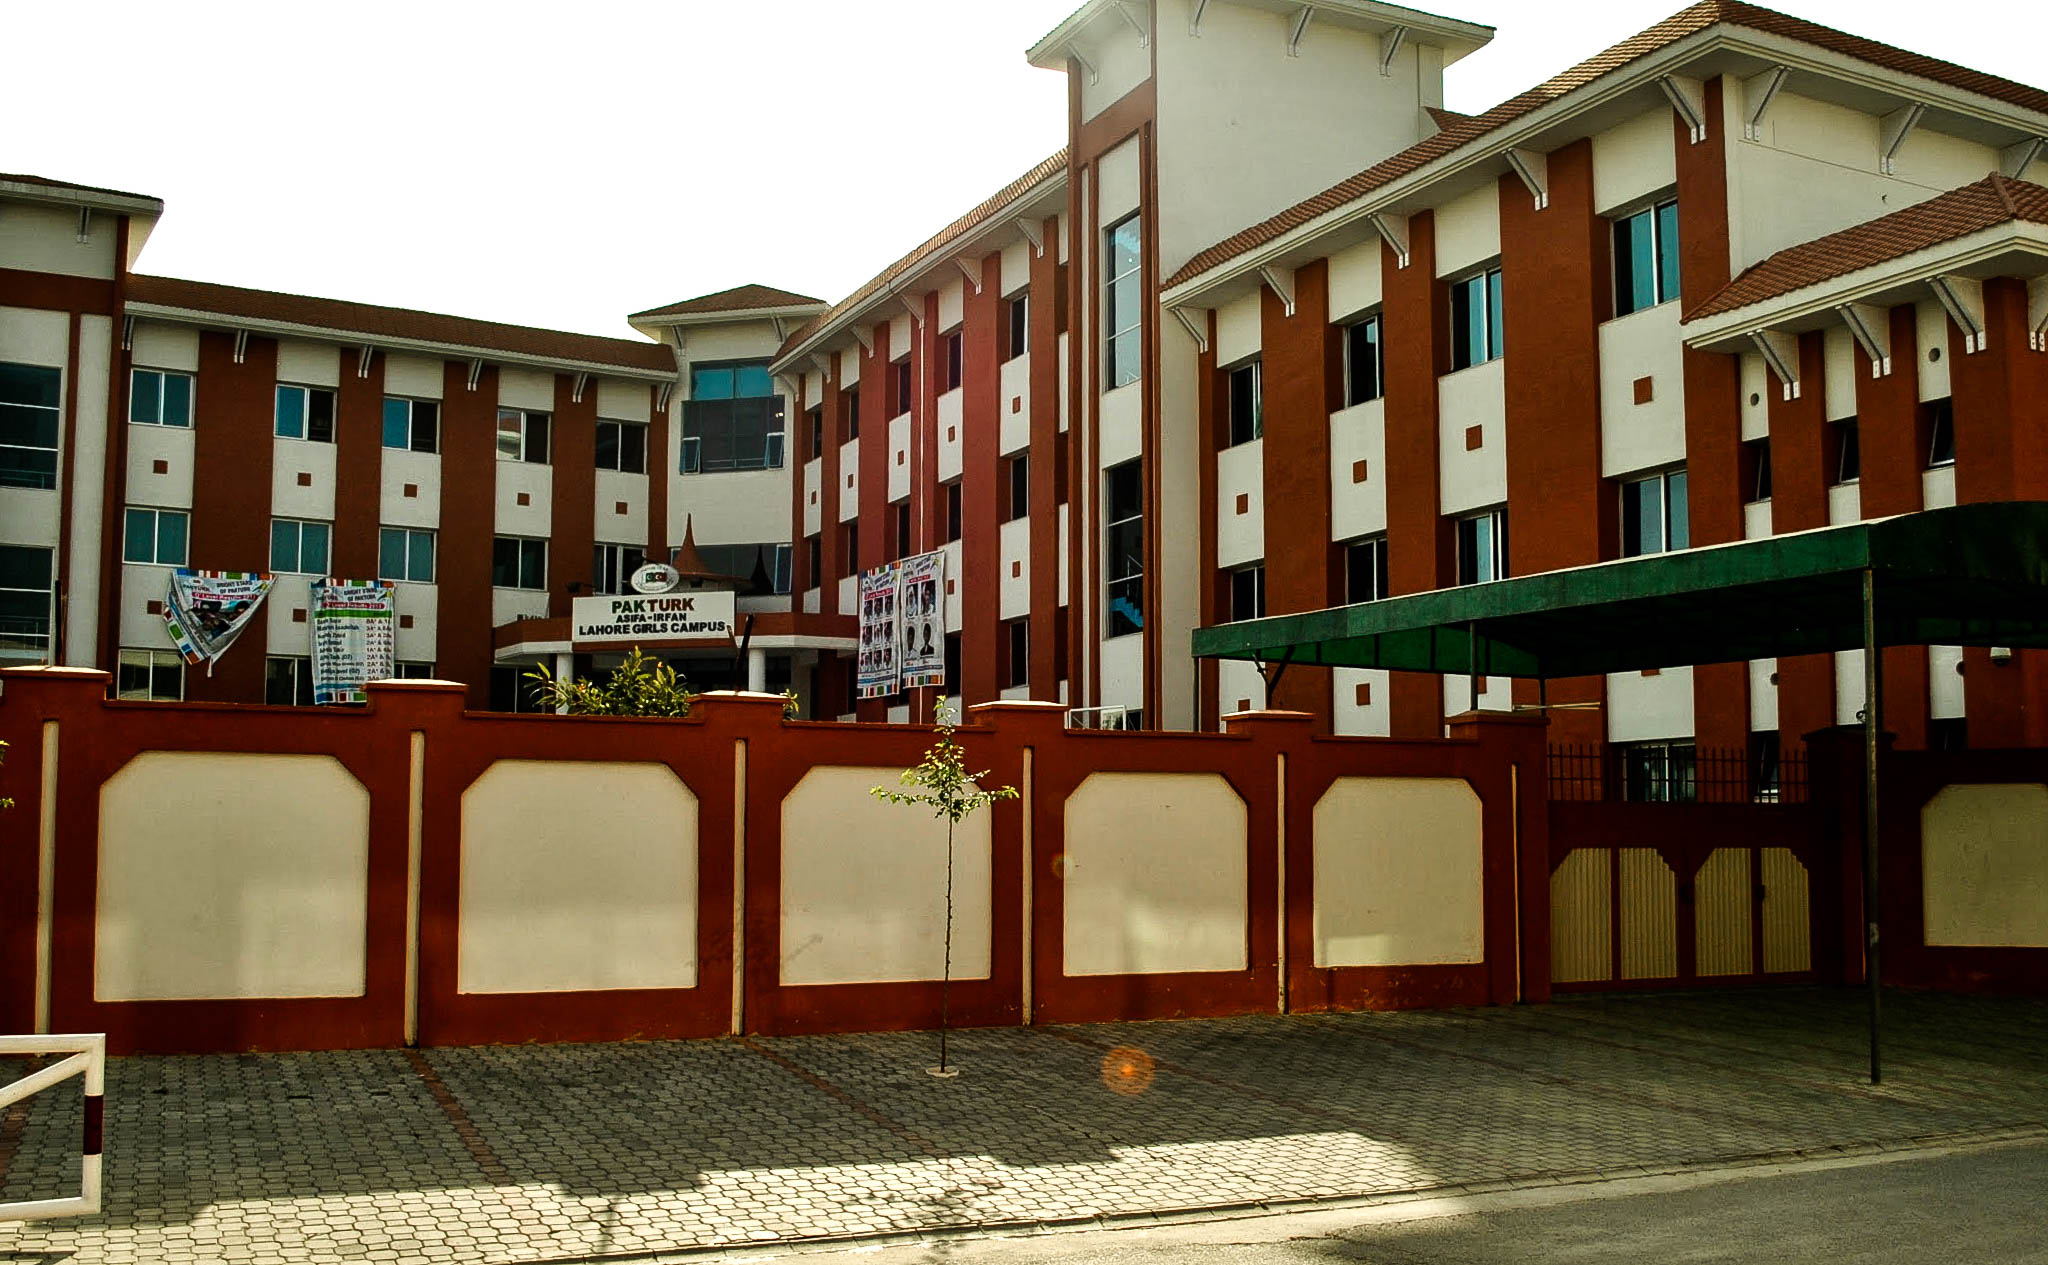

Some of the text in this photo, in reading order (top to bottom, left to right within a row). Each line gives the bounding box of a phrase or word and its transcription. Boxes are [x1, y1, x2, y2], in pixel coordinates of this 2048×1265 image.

[579, 621, 726, 636] LAHORE GIRLS CAMPUS
